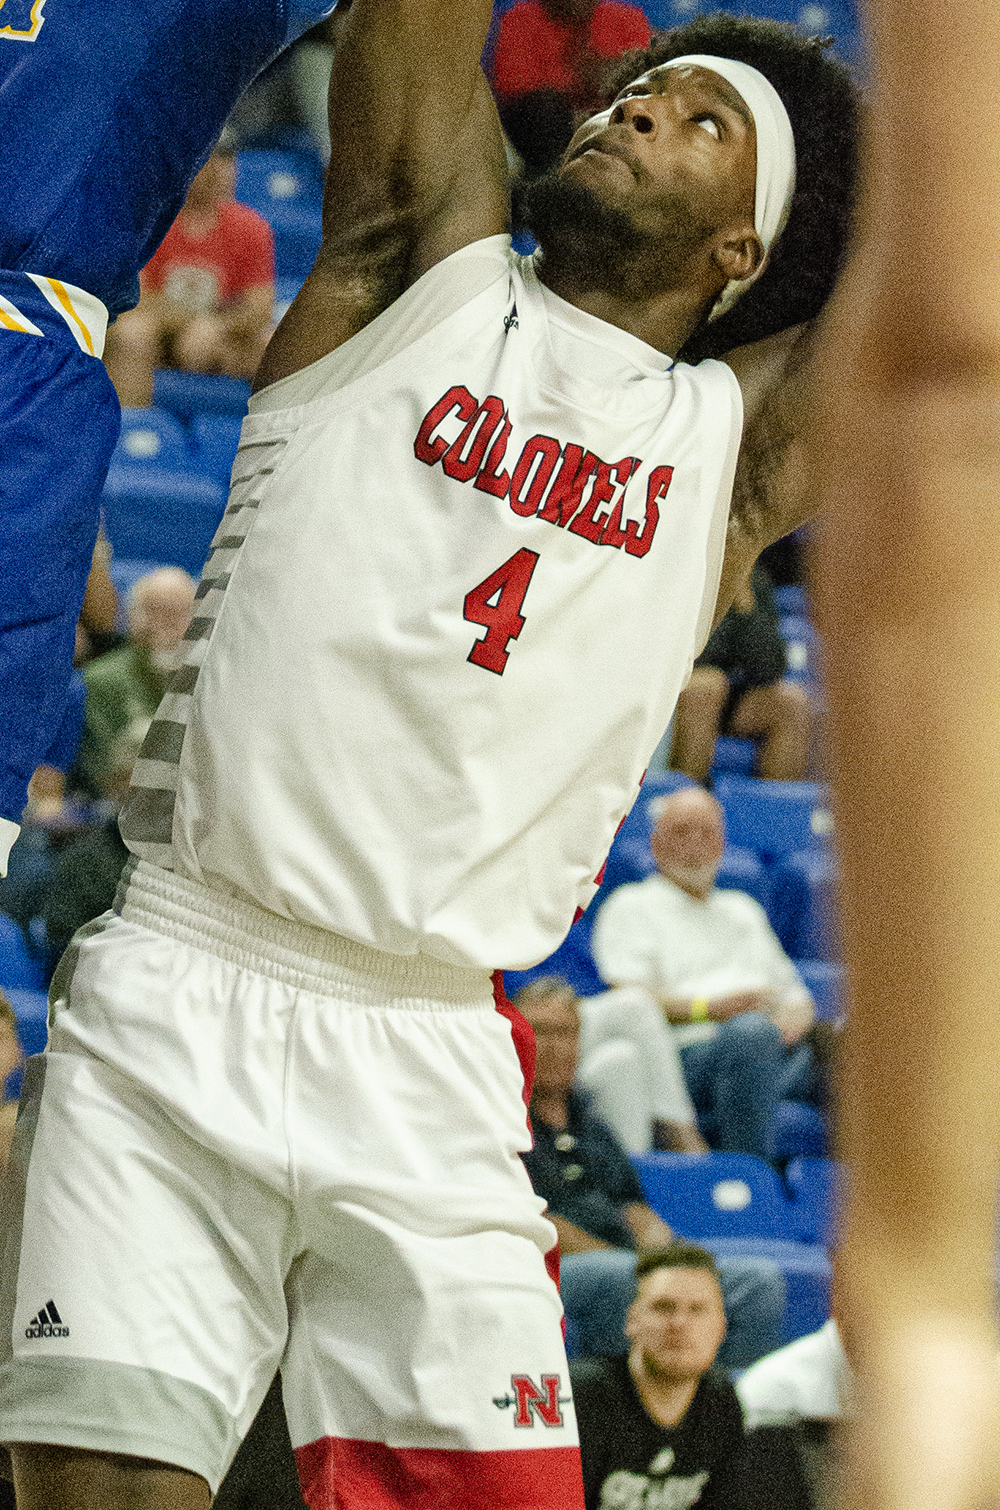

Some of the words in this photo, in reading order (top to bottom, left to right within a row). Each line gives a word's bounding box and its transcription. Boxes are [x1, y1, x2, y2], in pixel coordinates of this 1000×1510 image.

[413, 384, 675, 560] COLONELS
[462, 546, 541, 677] 4
[25, 1323, 70, 1339] adidas
[511, 1373, 564, 1428] N
